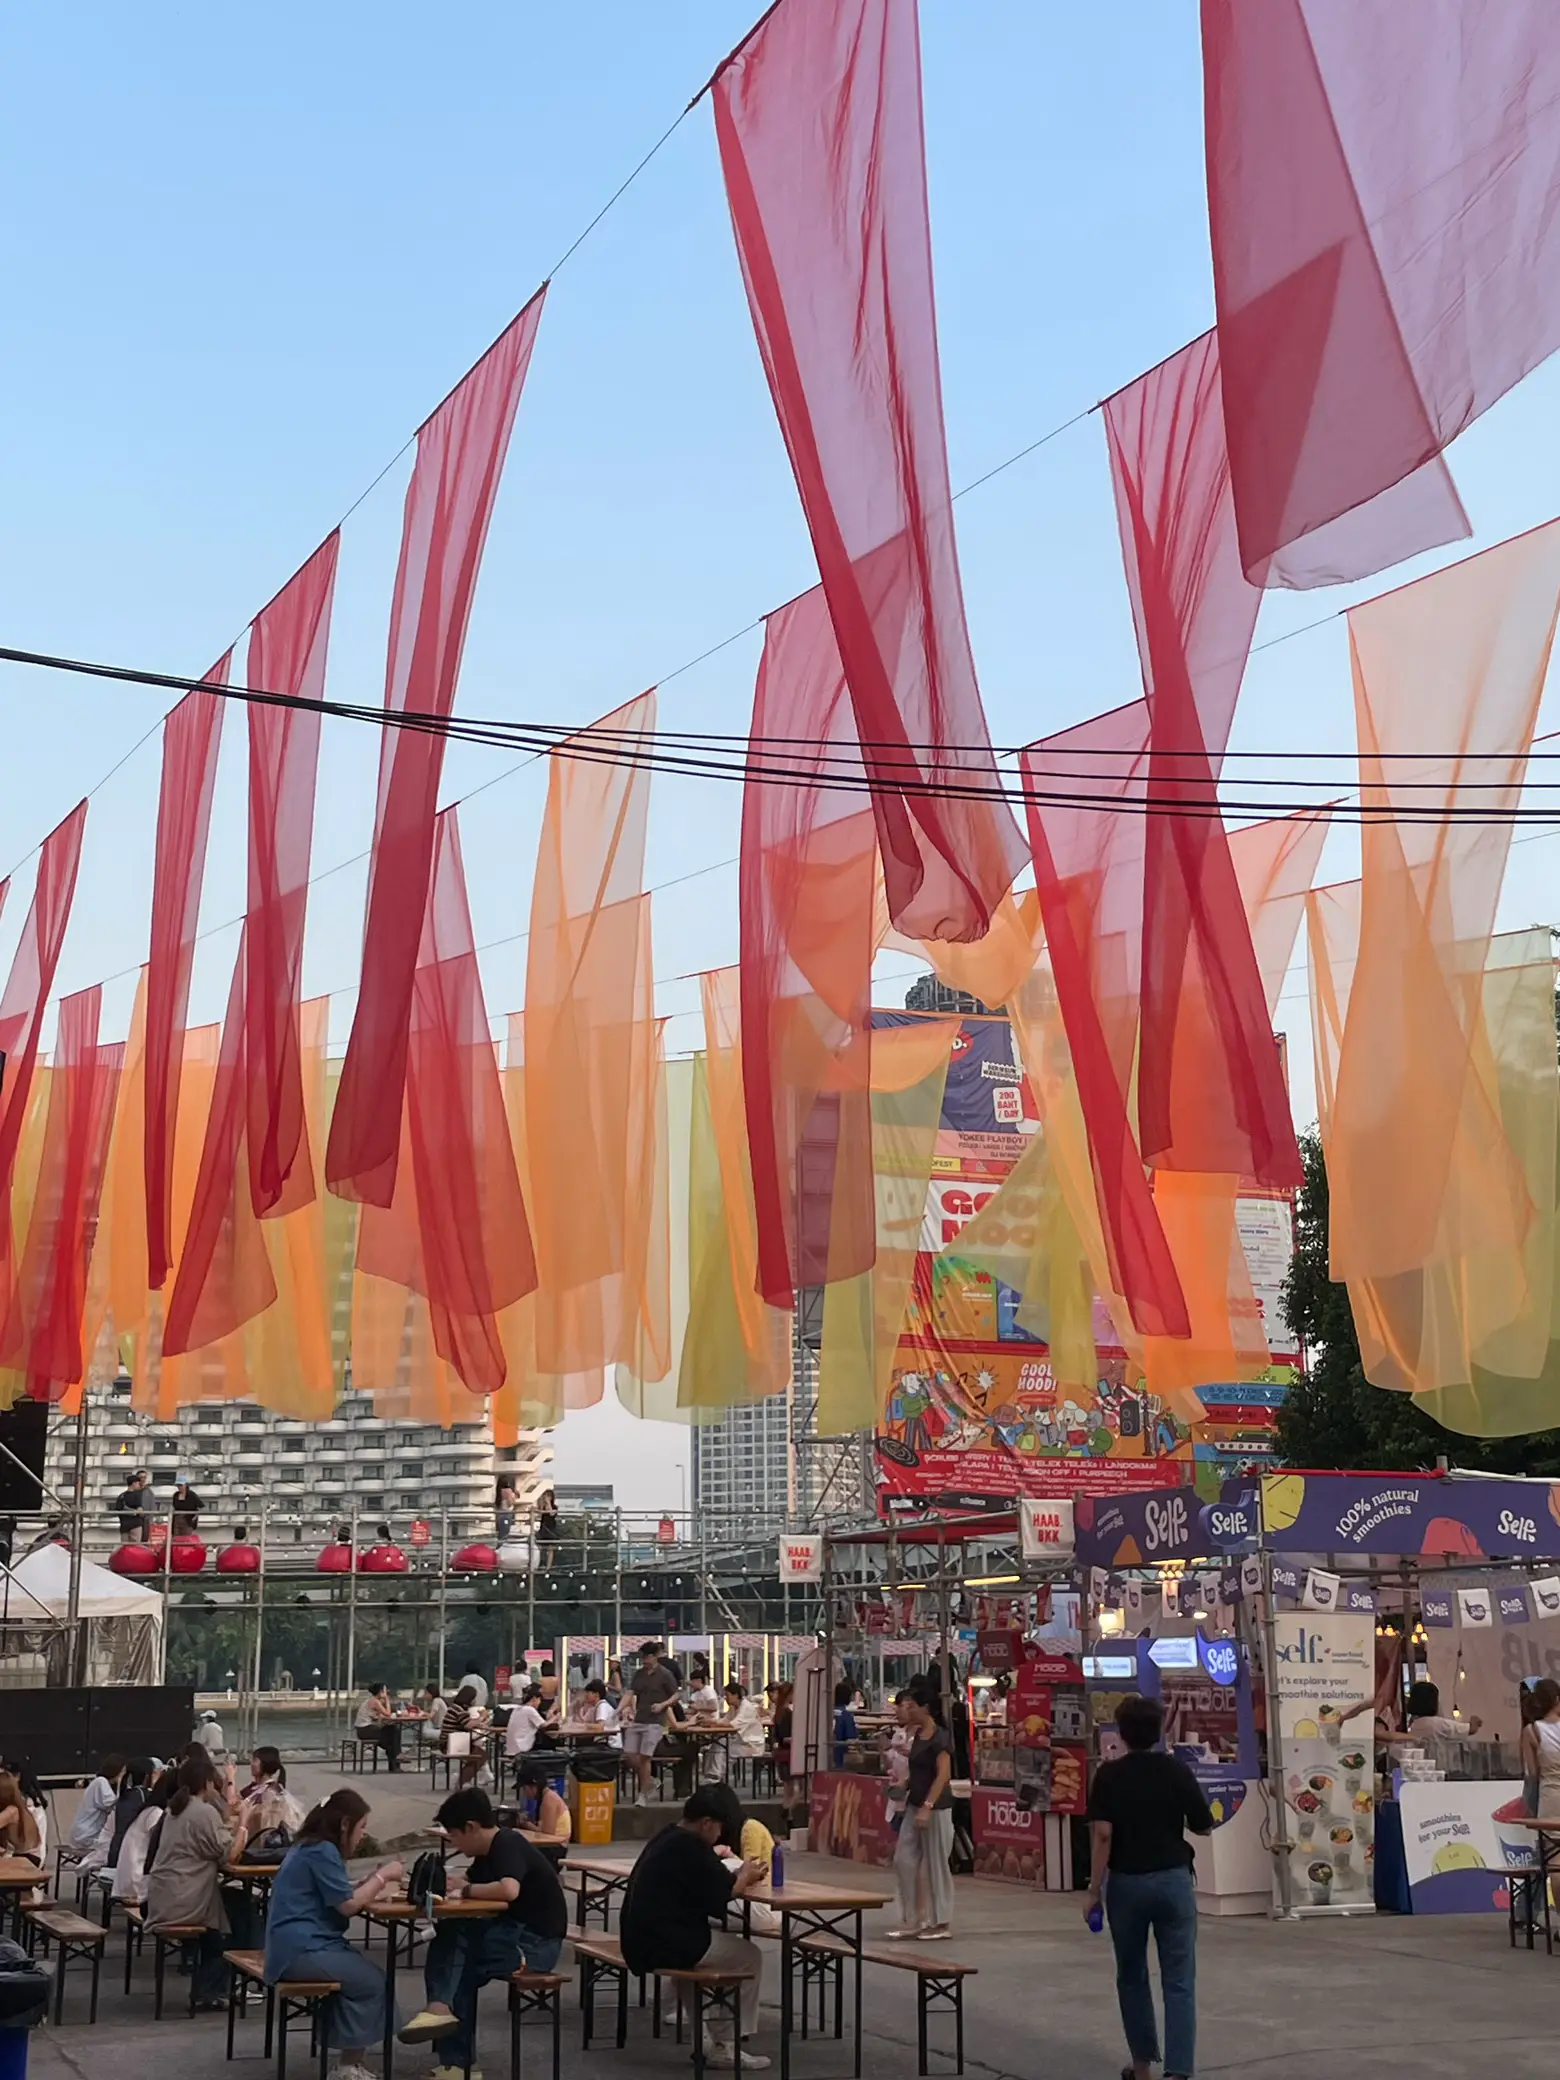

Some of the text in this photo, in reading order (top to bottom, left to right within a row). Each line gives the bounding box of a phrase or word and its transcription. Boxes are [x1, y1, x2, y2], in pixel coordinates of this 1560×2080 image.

[999, 1091, 1015, 1100] 200
[997, 1101, 1018, 1109] BAHT
[986, 1134, 1023, 1144] PLAYBOY
[1017, 1376, 1057, 1391] HOOD!
[1335, 1489, 1420, 1539] 100% natural
[1352, 1502, 1412, 1544] smoothies
[1037, 1529, 1060, 1543] BKK
[791, 1559, 809, 1570] BKK
[1293, 1676, 1328, 1687] explore
[1330, 1678, 1349, 1687] your
[1279, 1689, 1365, 1700] moothie solutions
[1419, 1812, 1462, 1830] smoothies
[1431, 1827, 1452, 1841] your
